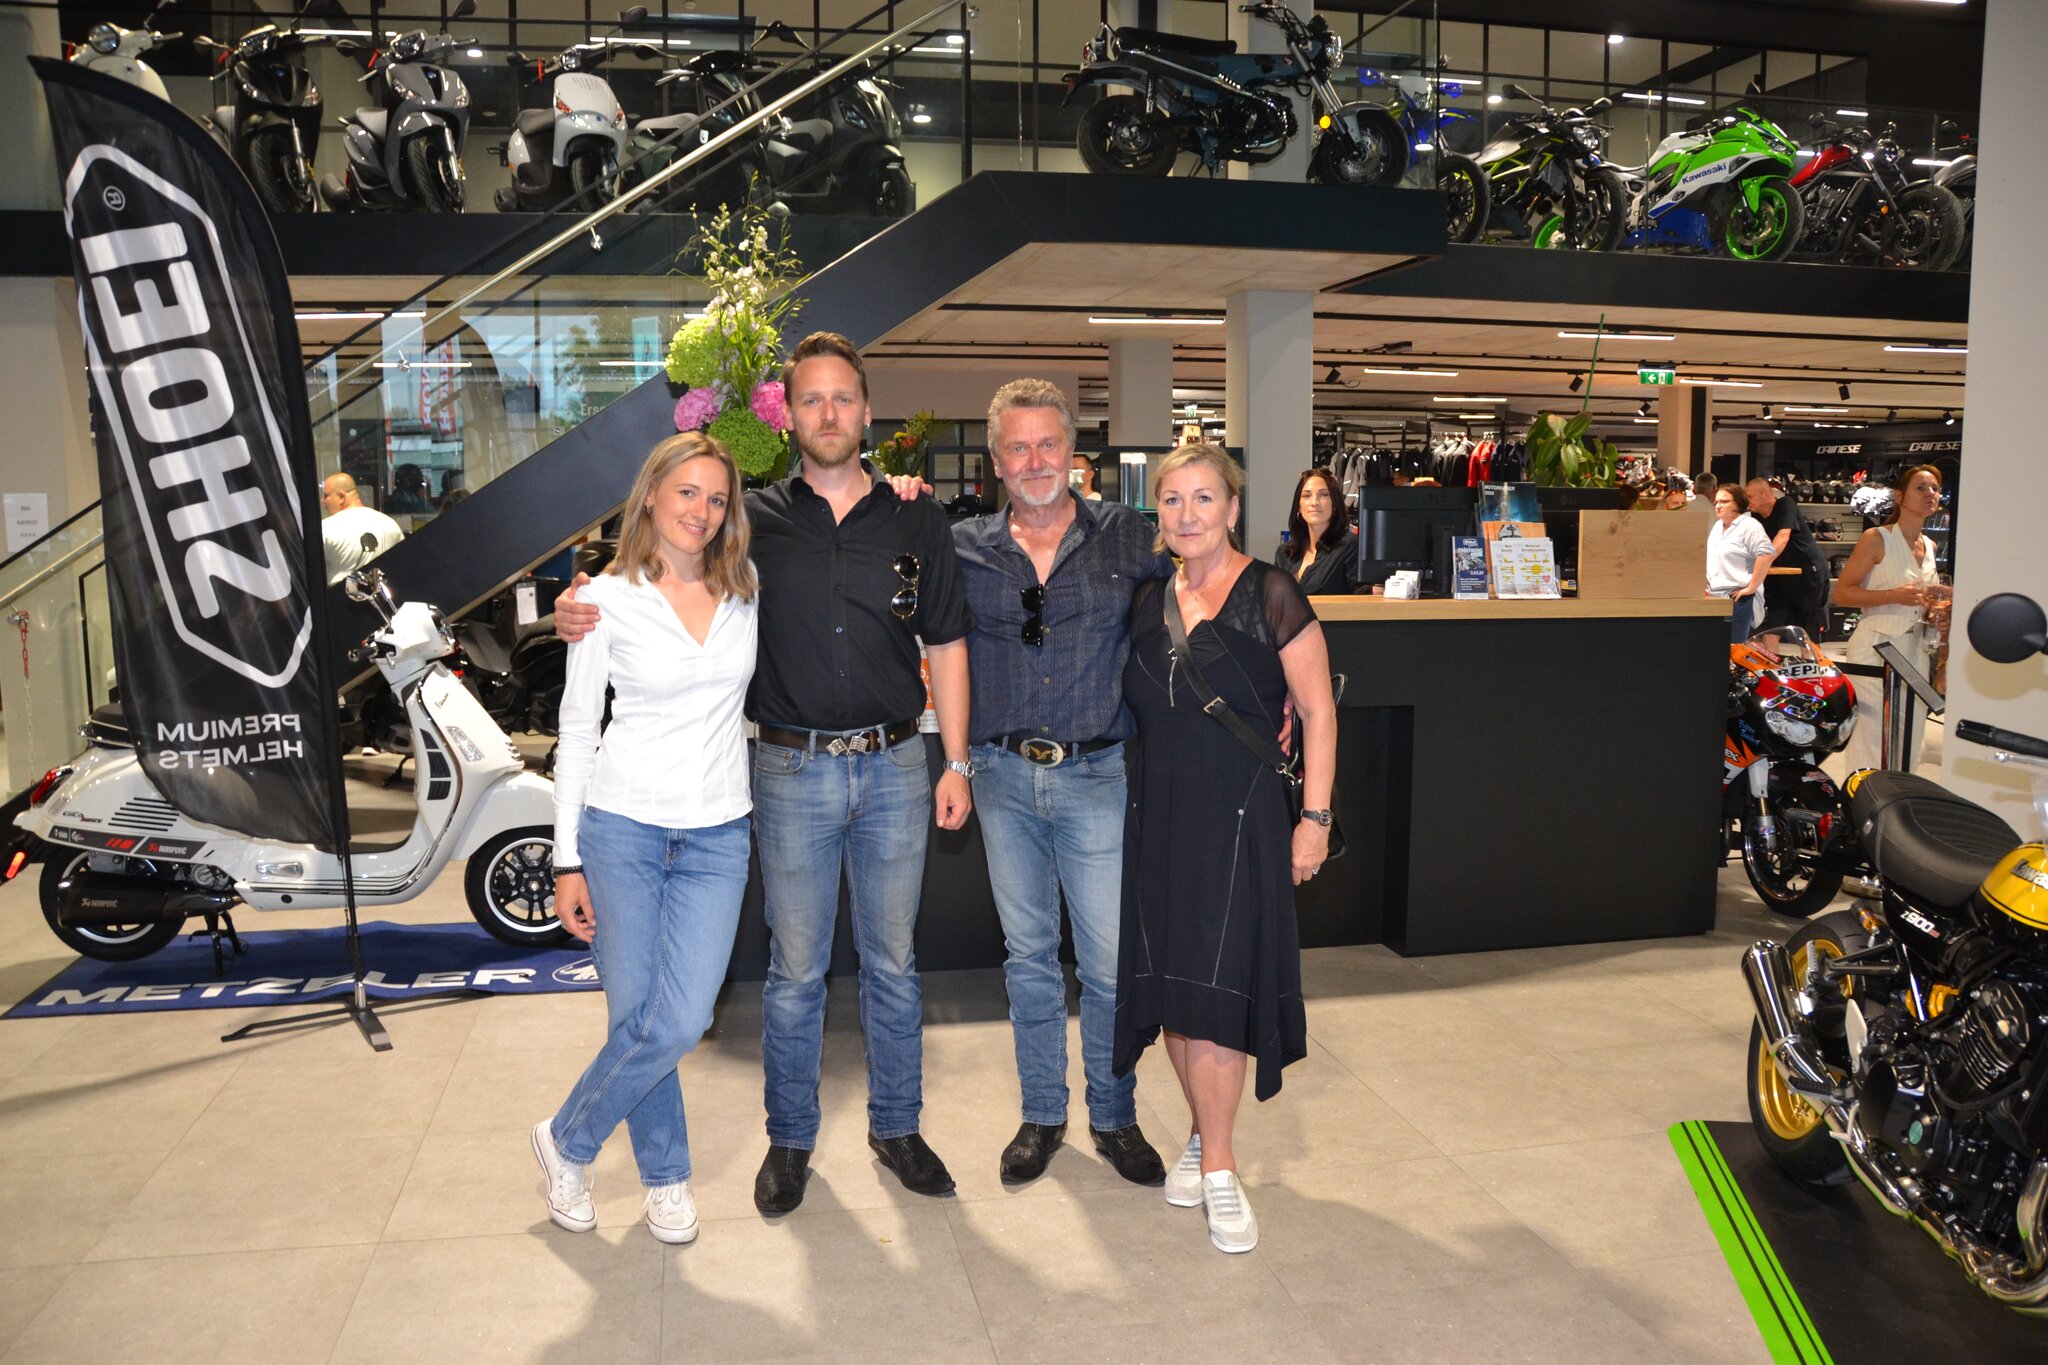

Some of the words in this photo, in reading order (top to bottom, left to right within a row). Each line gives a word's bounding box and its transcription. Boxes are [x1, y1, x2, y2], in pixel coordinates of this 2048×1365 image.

[1682, 162, 1727, 185] Kawasaki
[1816, 444, 1862, 455] DAINESE
[1908, 440, 1962, 452] DAINESE
[37, 968, 539, 1006] METZELER
